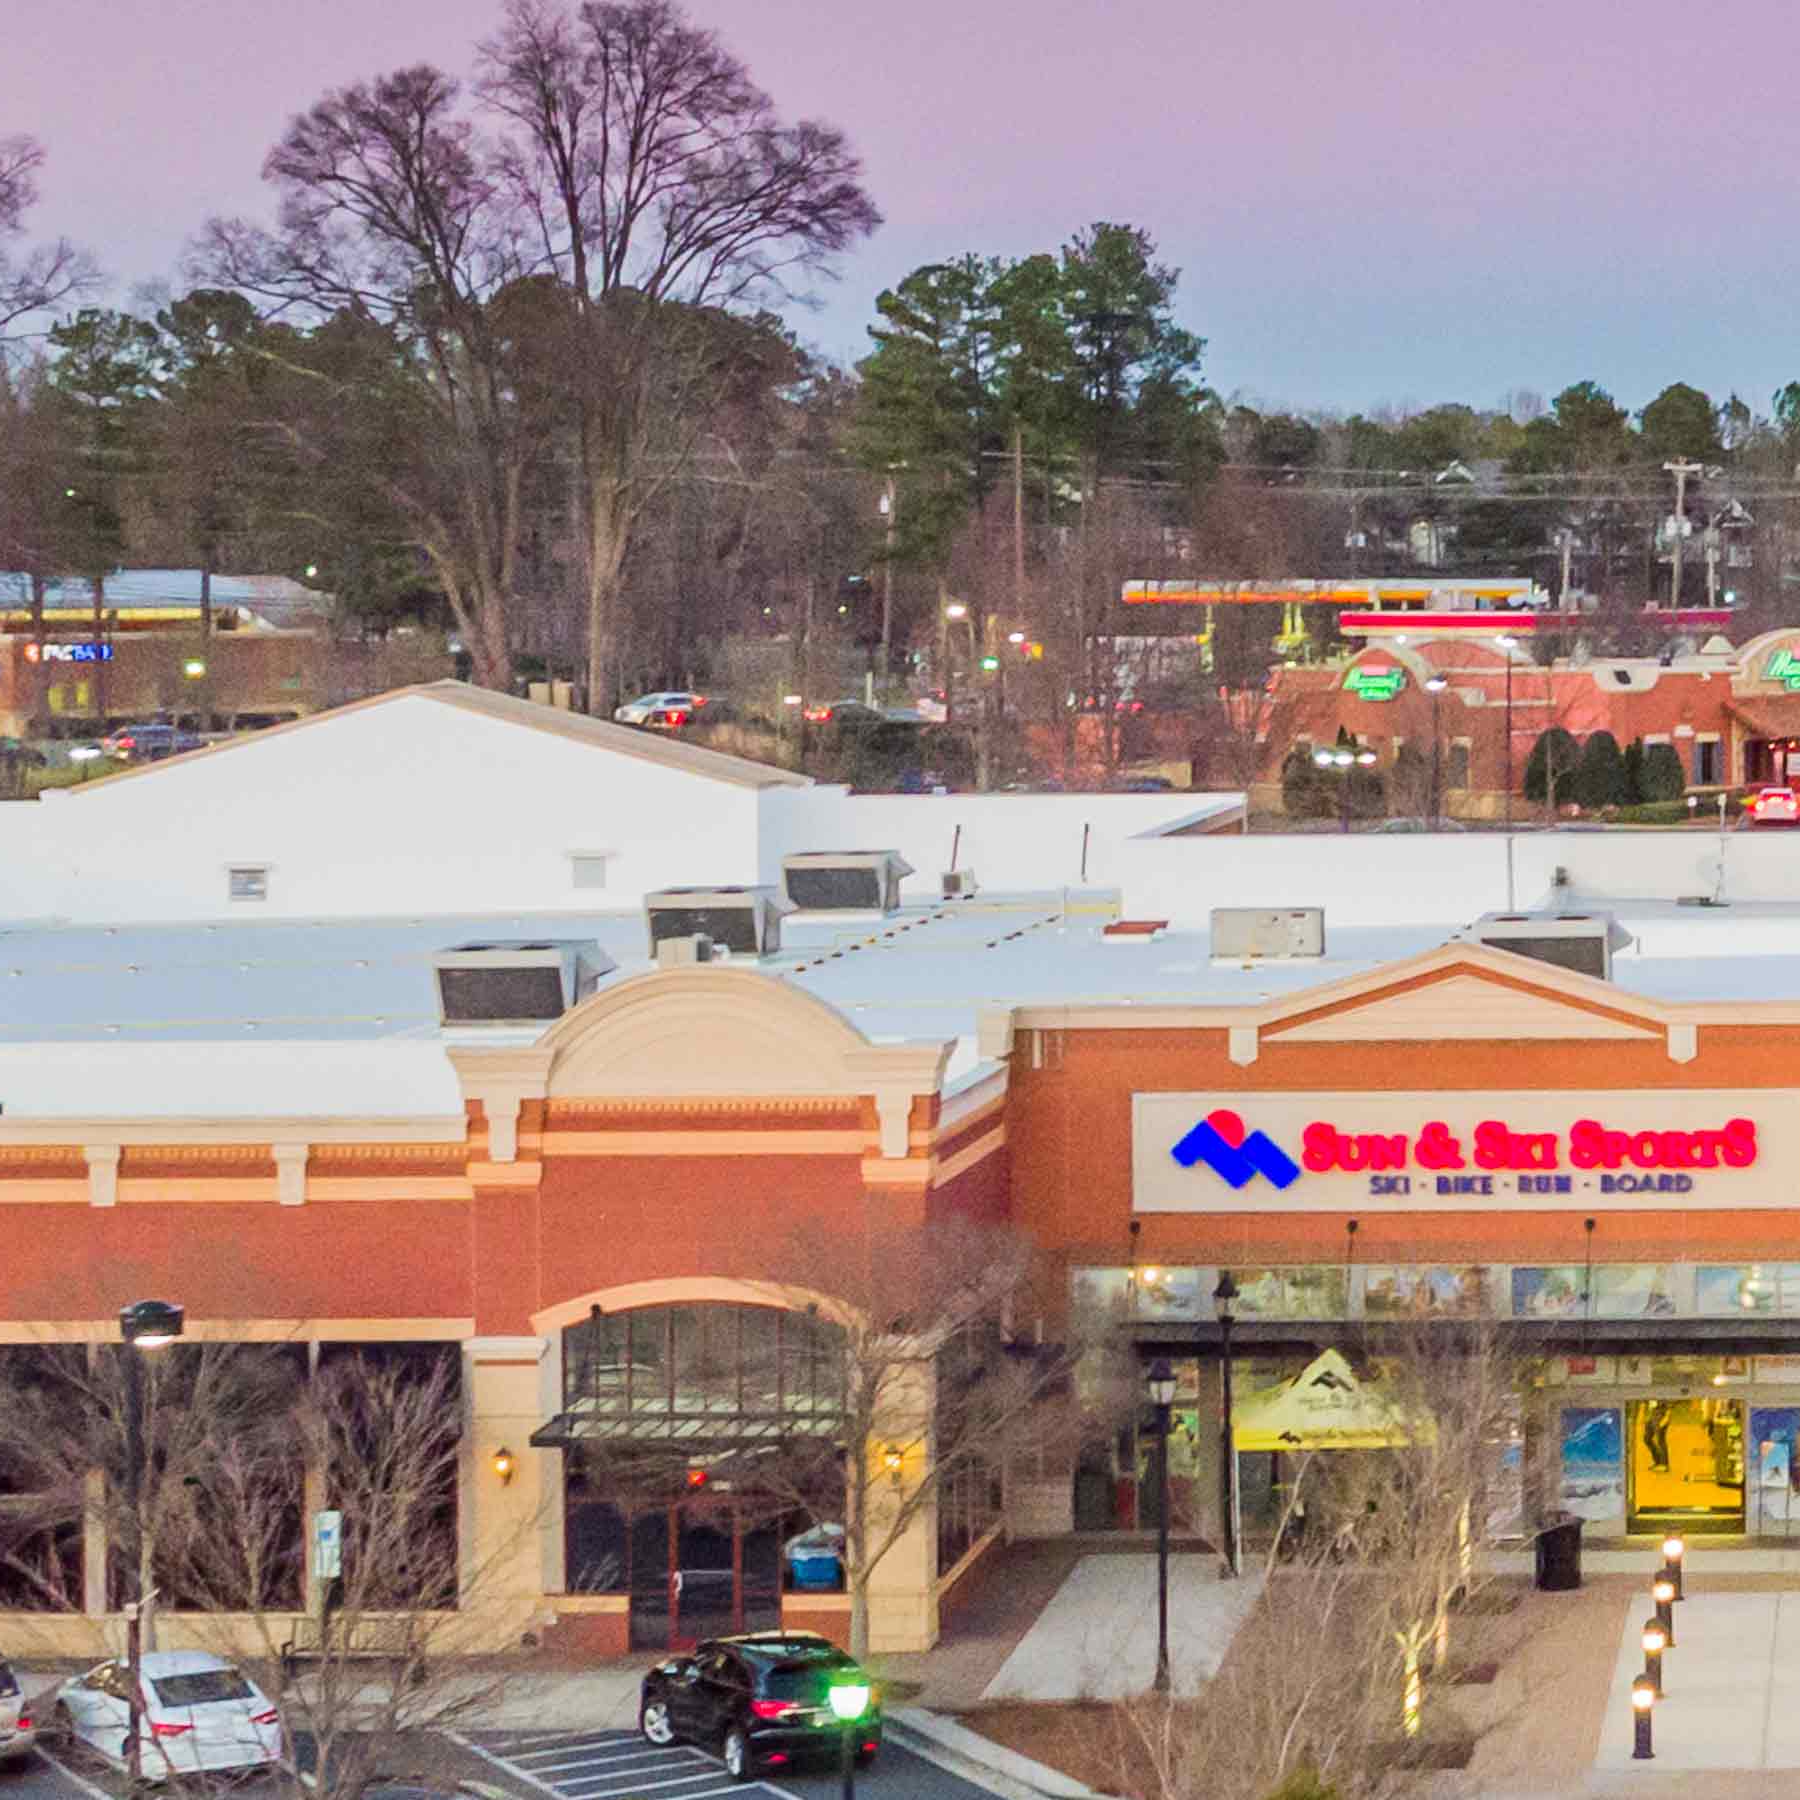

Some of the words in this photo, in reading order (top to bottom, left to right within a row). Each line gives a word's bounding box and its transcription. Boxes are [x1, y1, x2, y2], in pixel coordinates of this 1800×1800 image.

[1302, 1121, 1408, 1172] SUN
[1414, 1121, 1465, 1170] &
[1473, 1120, 1557, 1170] SKI
[1569, 1118, 1757, 1169] SPORTS
[1369, 1175, 1410, 1195] SKI
[1436, 1175, 1493, 1195] BIKE
[1517, 1174, 1571, 1194] RUN
[1600, 1173, 1693, 1194] BOARD
